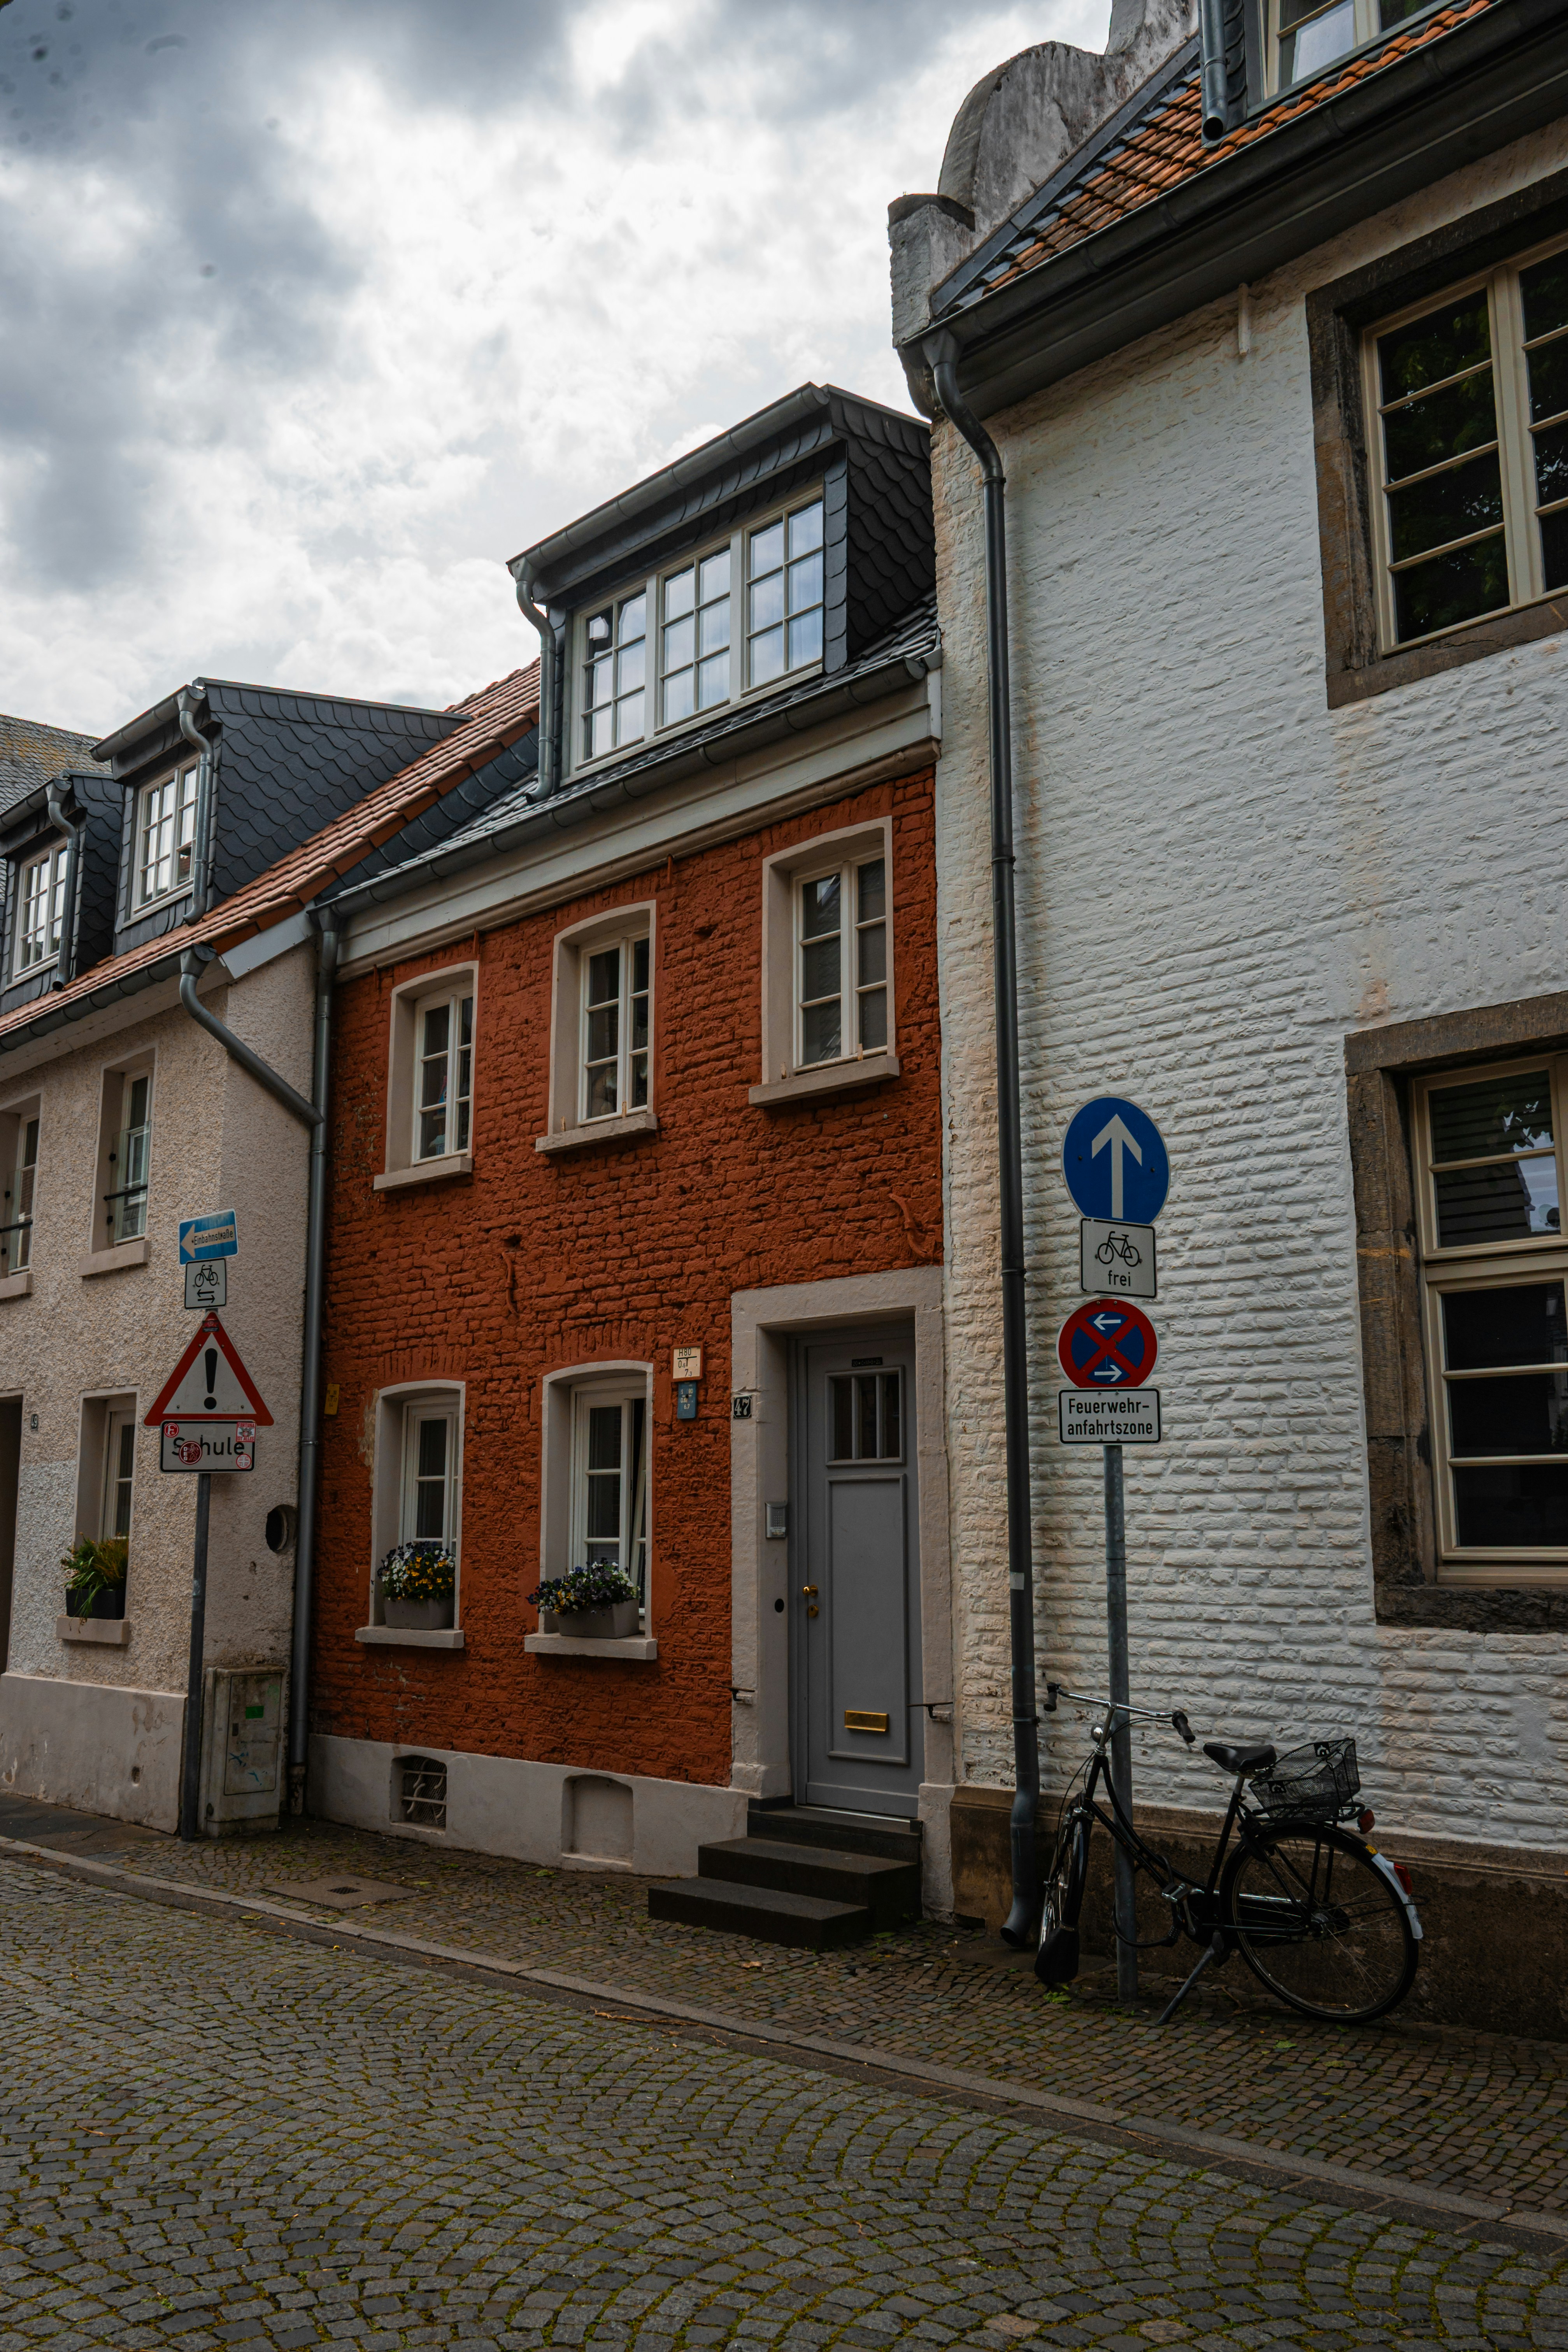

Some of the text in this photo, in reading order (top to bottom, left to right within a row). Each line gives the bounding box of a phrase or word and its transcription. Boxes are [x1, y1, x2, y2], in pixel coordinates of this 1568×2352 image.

[194, 1228, 233, 1245] Einbahnstraße
[1108, 1270, 1131, 1287] frei
[735, 1398, 749, 1415] 47
[1069, 1398, 1149, 1414] Feuerwehr-
[31, 1415, 37, 1428] 49
[1067, 1419, 1152, 1435] anfahrtszone
[172, 1436, 244, 1456] Shule
